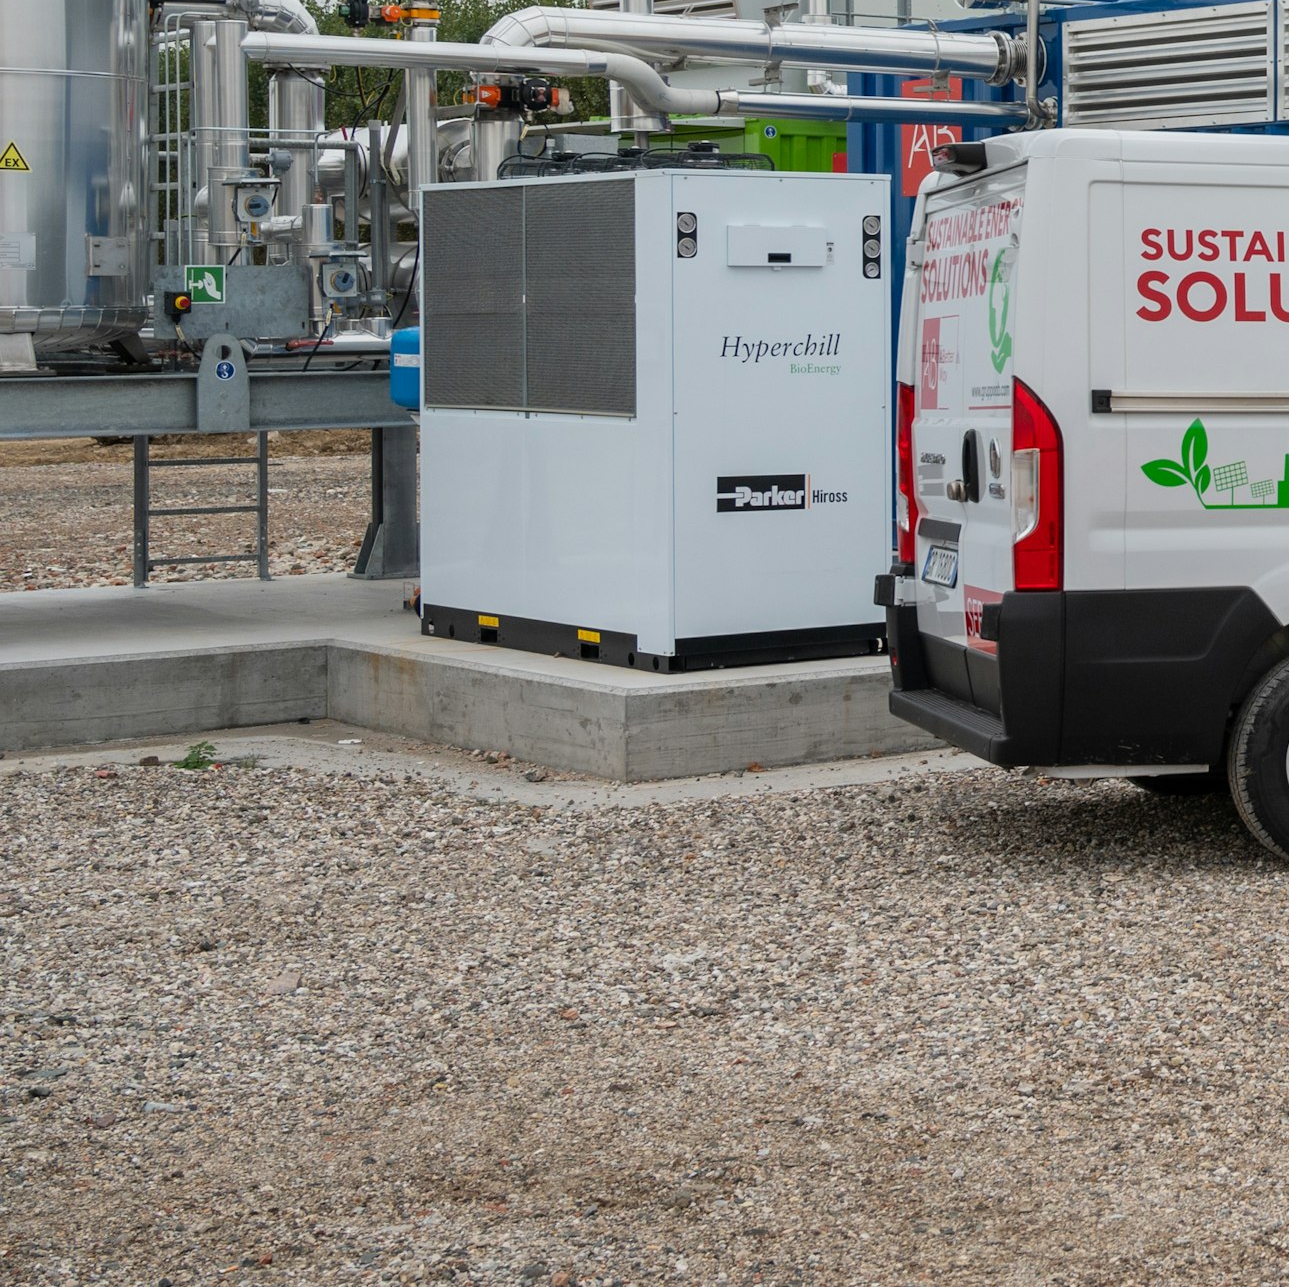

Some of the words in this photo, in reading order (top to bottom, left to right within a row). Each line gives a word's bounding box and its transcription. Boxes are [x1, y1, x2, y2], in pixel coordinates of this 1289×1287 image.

[5, 158, 20, 167] EX
[926, 210, 985, 252] SUSTAINABLE
[985, 197, 1025, 240] ENER
[920, 248, 989, 304] SOLUTIONS
[719, 333, 841, 363] Hyperchill
[790, 363, 842, 375] BioEnergy
[735, 485, 804, 507] Parker
[812, 490, 848, 503] Hiross
